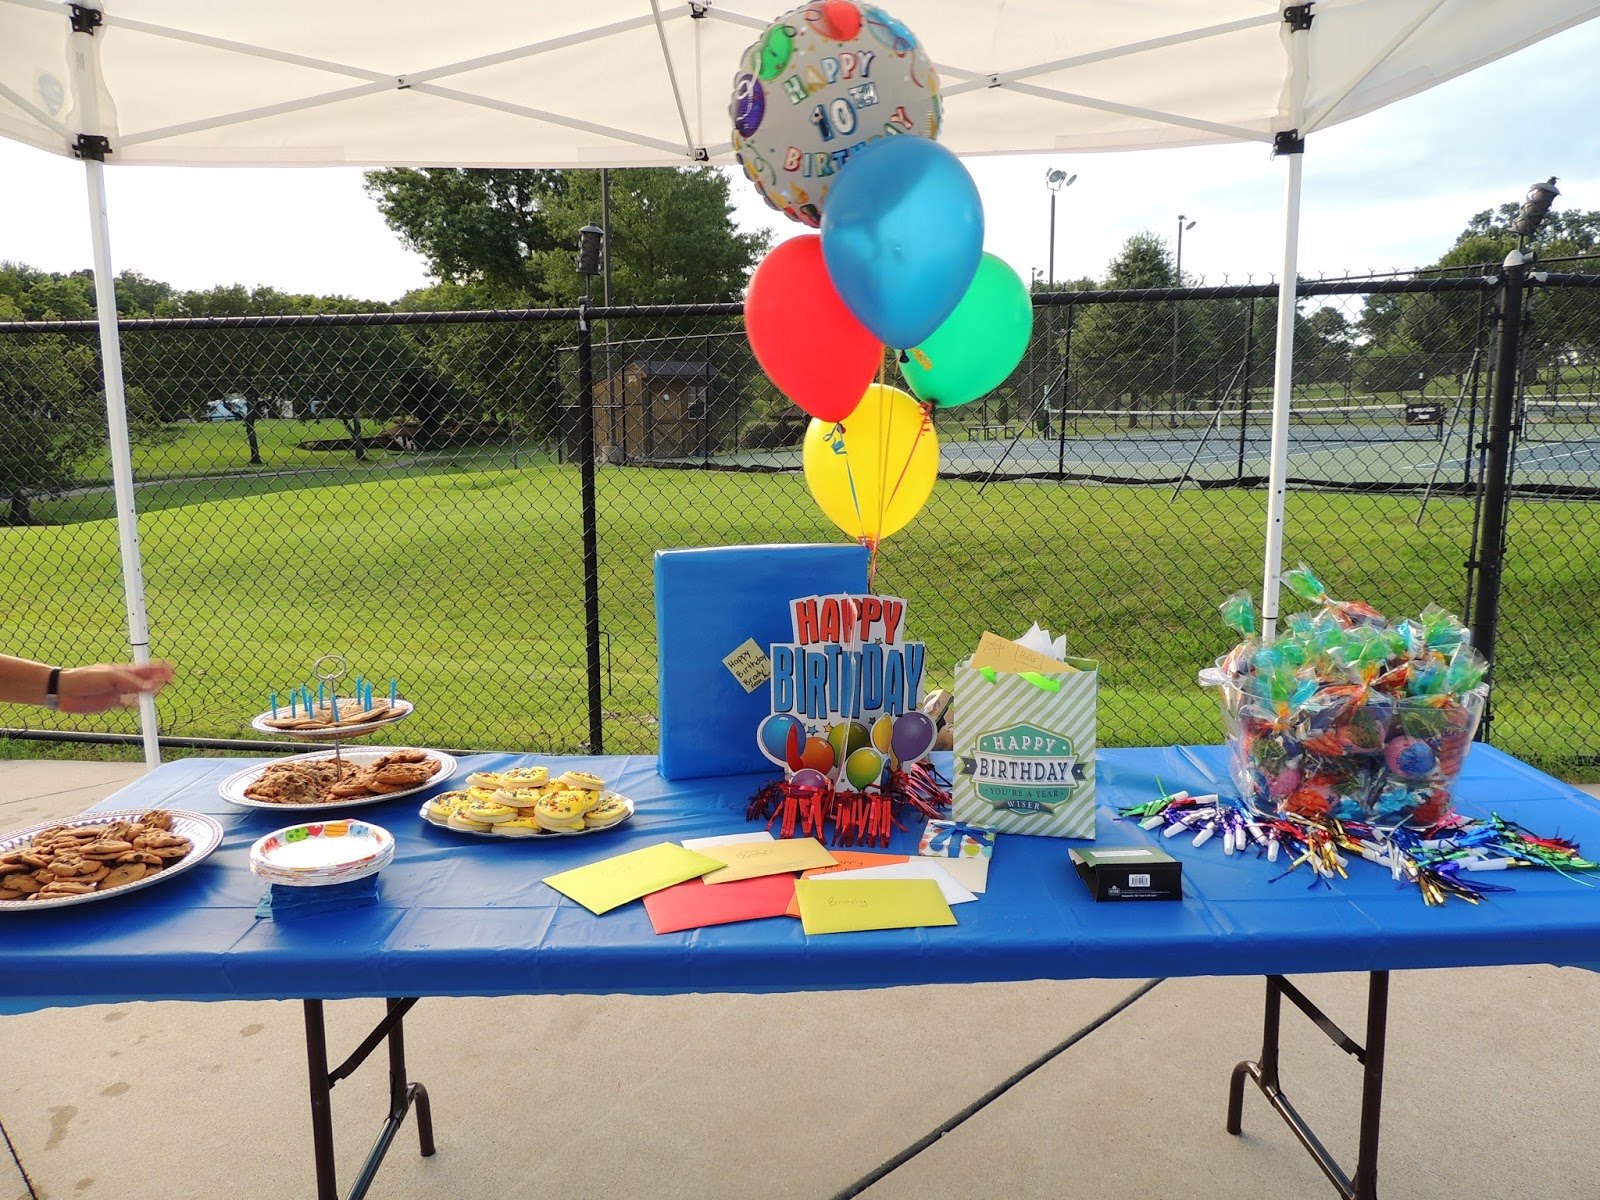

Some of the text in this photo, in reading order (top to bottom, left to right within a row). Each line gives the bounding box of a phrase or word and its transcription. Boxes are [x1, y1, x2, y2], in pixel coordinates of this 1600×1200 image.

[782, 50, 876, 105] HAPPY
[784, 106, 913, 178] BIRTY
[795, 598, 903, 645] HAPPY
[727, 650, 751, 668] Happy
[735, 655, 768, 678] Birthday
[993, 736, 1056, 753] HAPPY
[980, 758, 1068, 782] BIRTHDAY
[990, 787, 1059, 798] YOU'RE A YEAR
[1007, 800, 1040, 810] WISER
